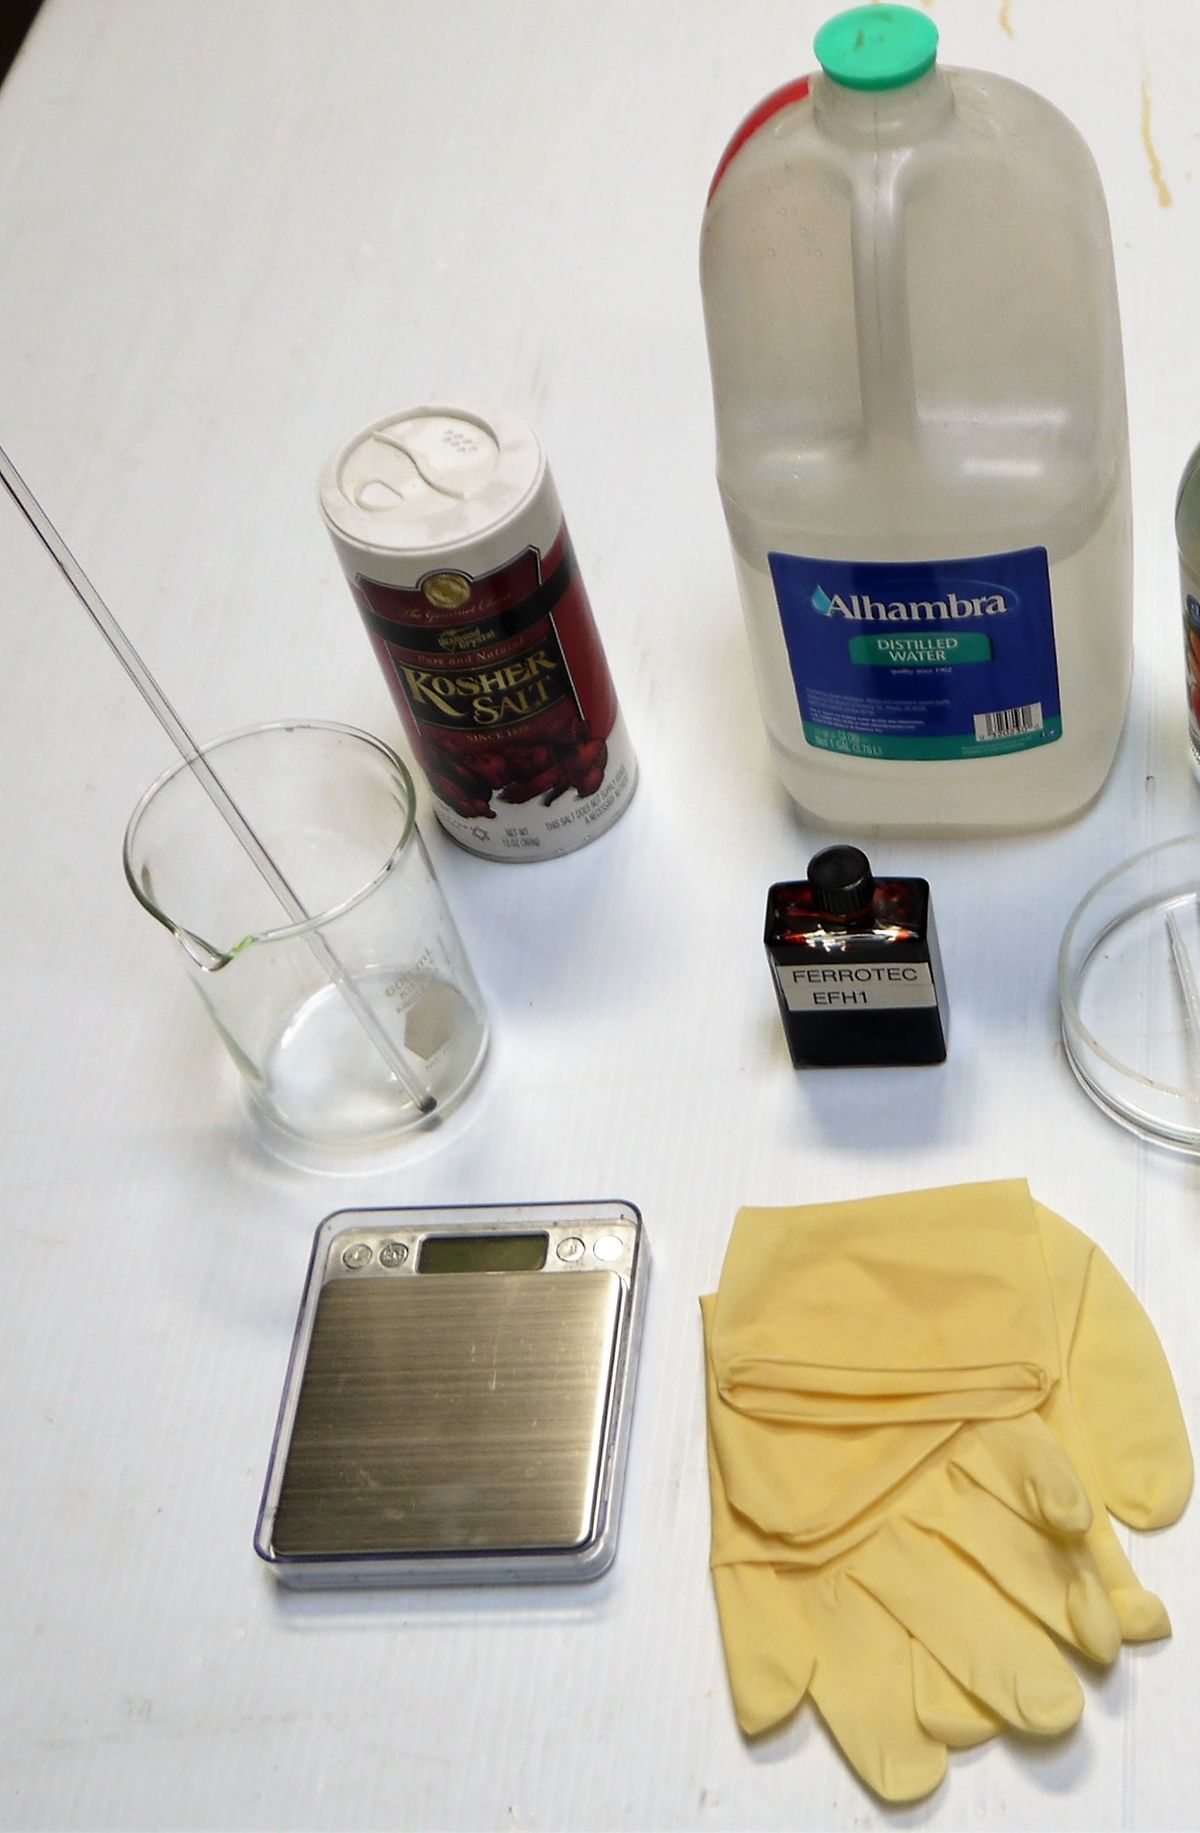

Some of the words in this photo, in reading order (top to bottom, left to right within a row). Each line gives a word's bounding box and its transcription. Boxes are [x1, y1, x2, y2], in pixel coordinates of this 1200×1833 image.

[827, 593, 1007, 621] Alhambra
[877, 637, 959, 650] DISTILLED
[889, 650, 948, 662] WATER
[401, 650, 558, 718] KOSHER
[472, 680, 550, 725] SALT
[792, 967, 918, 983] FERROTEC
[813, 991, 868, 1005] EFH1
